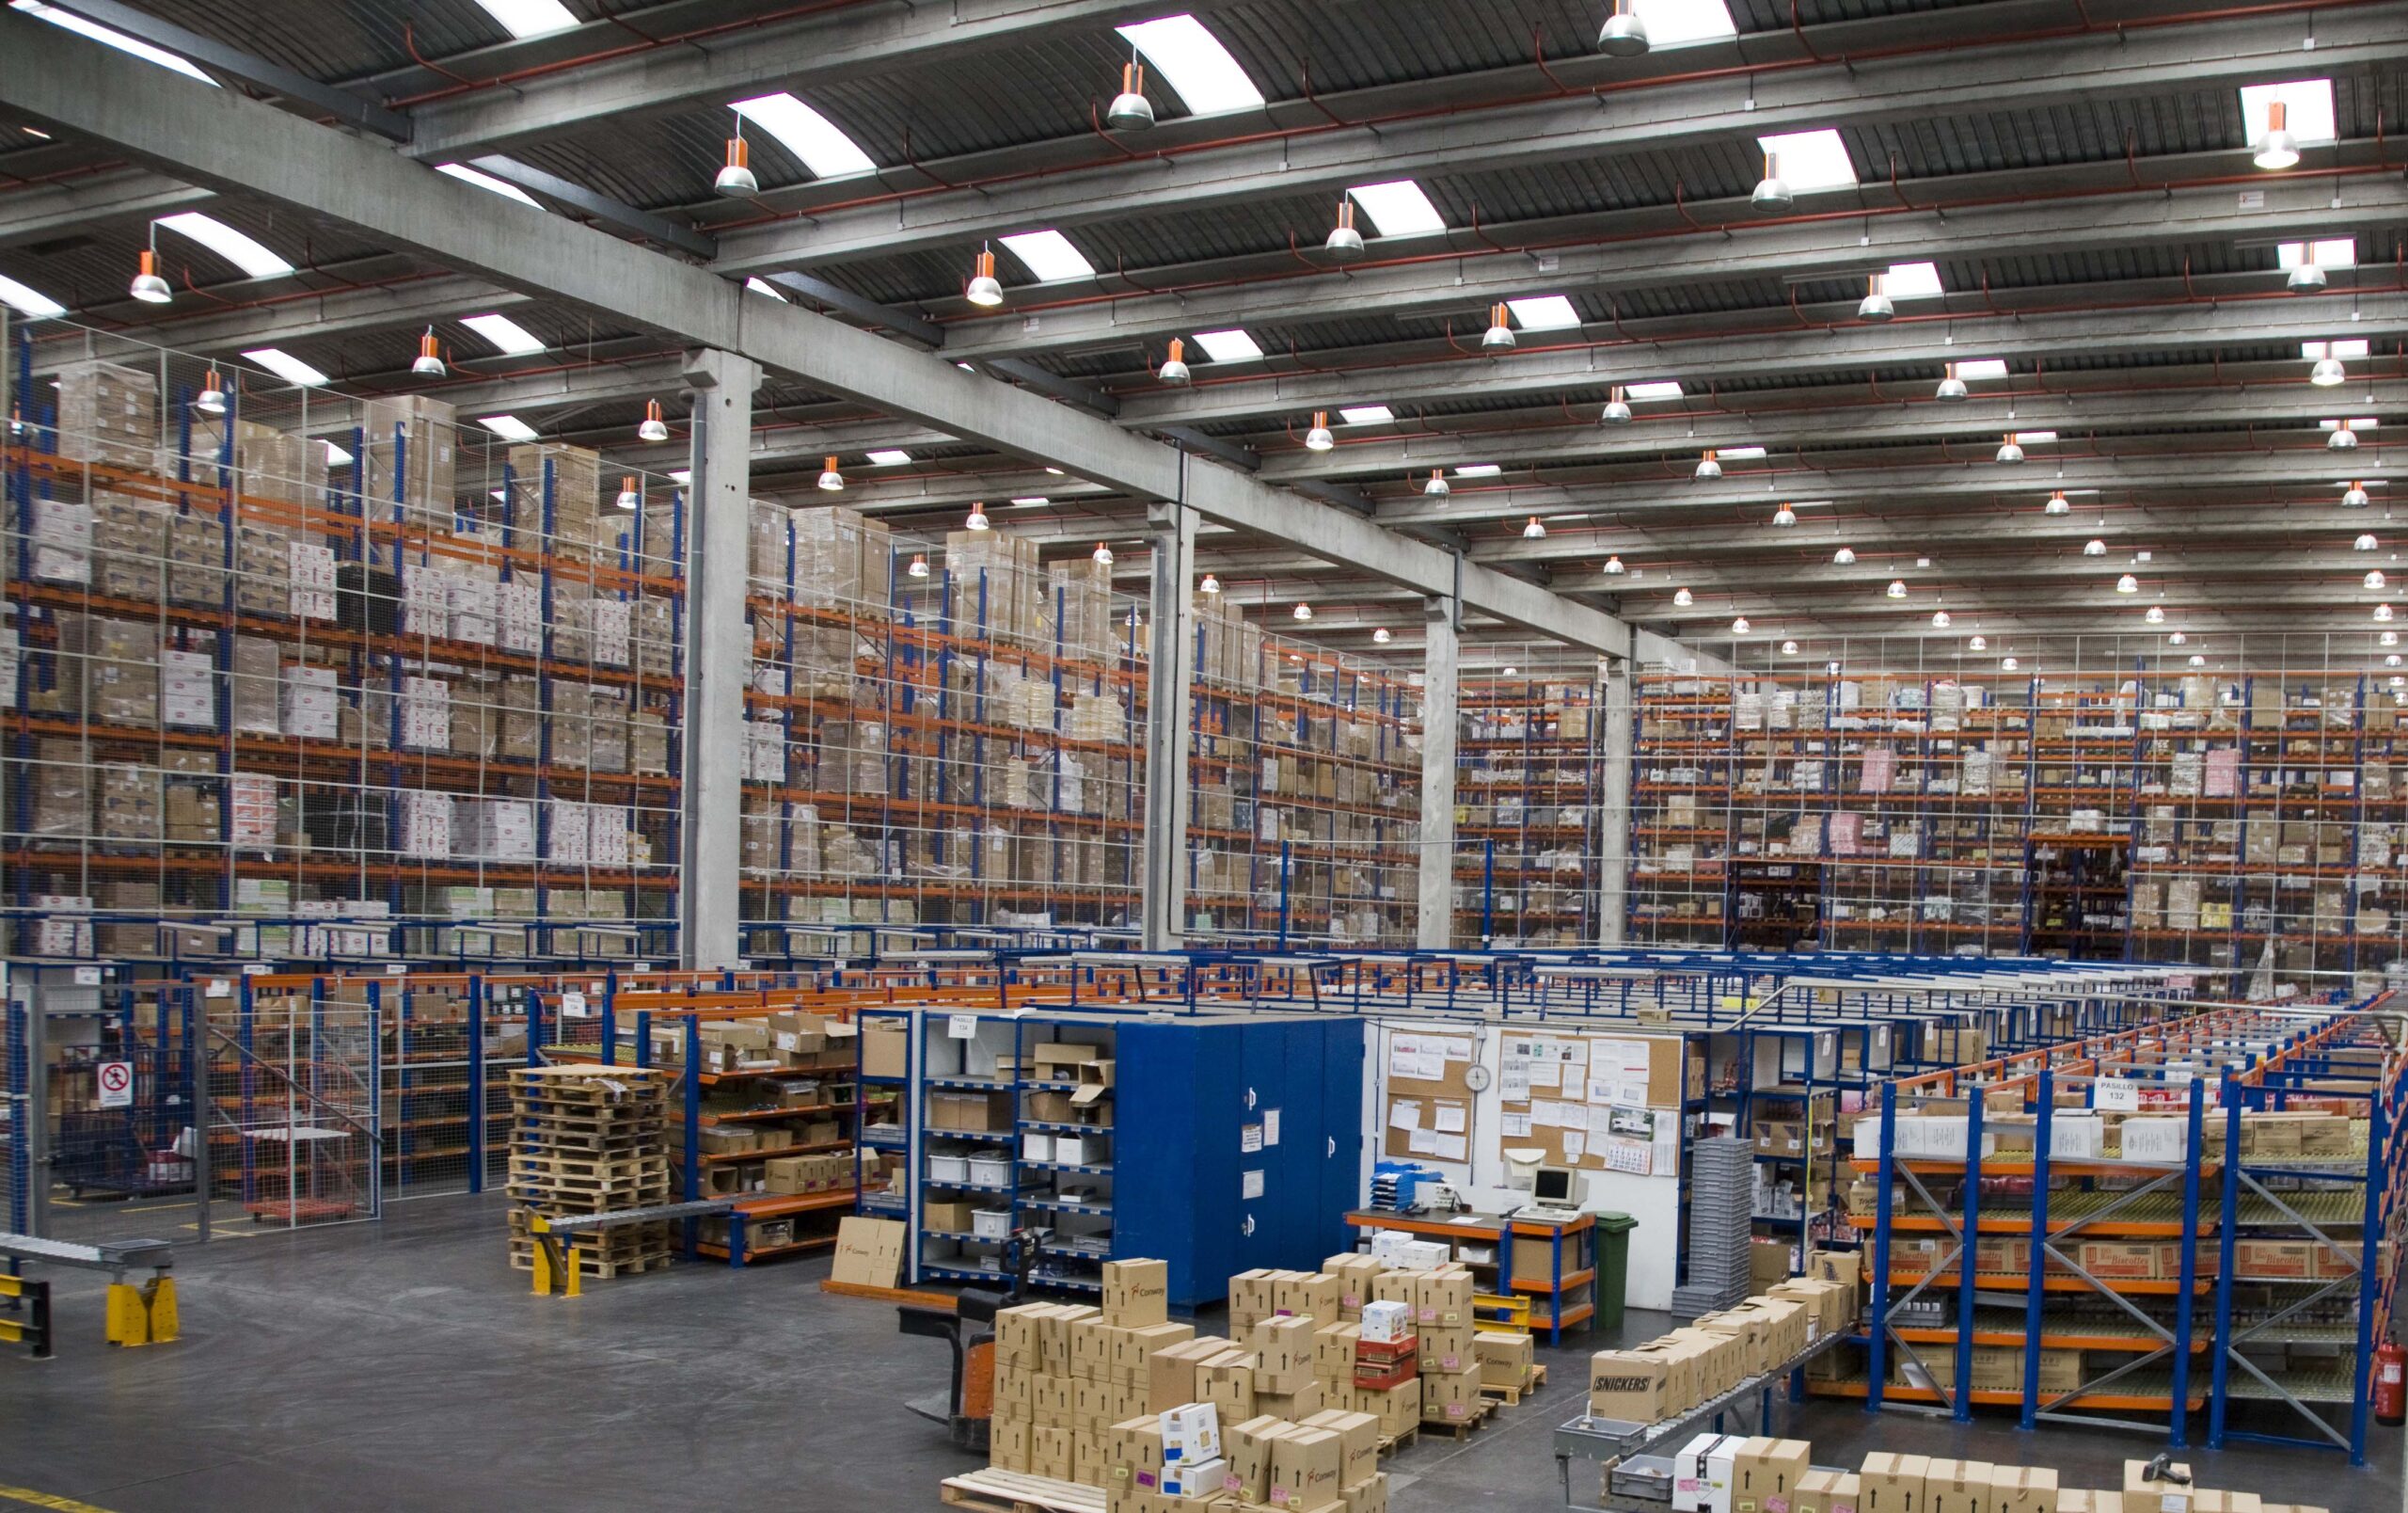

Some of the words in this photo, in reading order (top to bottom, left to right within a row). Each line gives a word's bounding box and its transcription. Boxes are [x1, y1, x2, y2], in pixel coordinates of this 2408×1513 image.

[1896, 1250, 1930, 1260] Biscottes
[2112, 1254, 2148, 1265] Biscottes
[2266, 1254, 2304, 1265] Biscottes
[1140, 1288, 1165, 1297] Conway
[1486, 1357, 1513, 1368] Conway
[1595, 1377, 1648, 1391] SNICKERS
[1315, 1469, 1336, 1483] Conway
